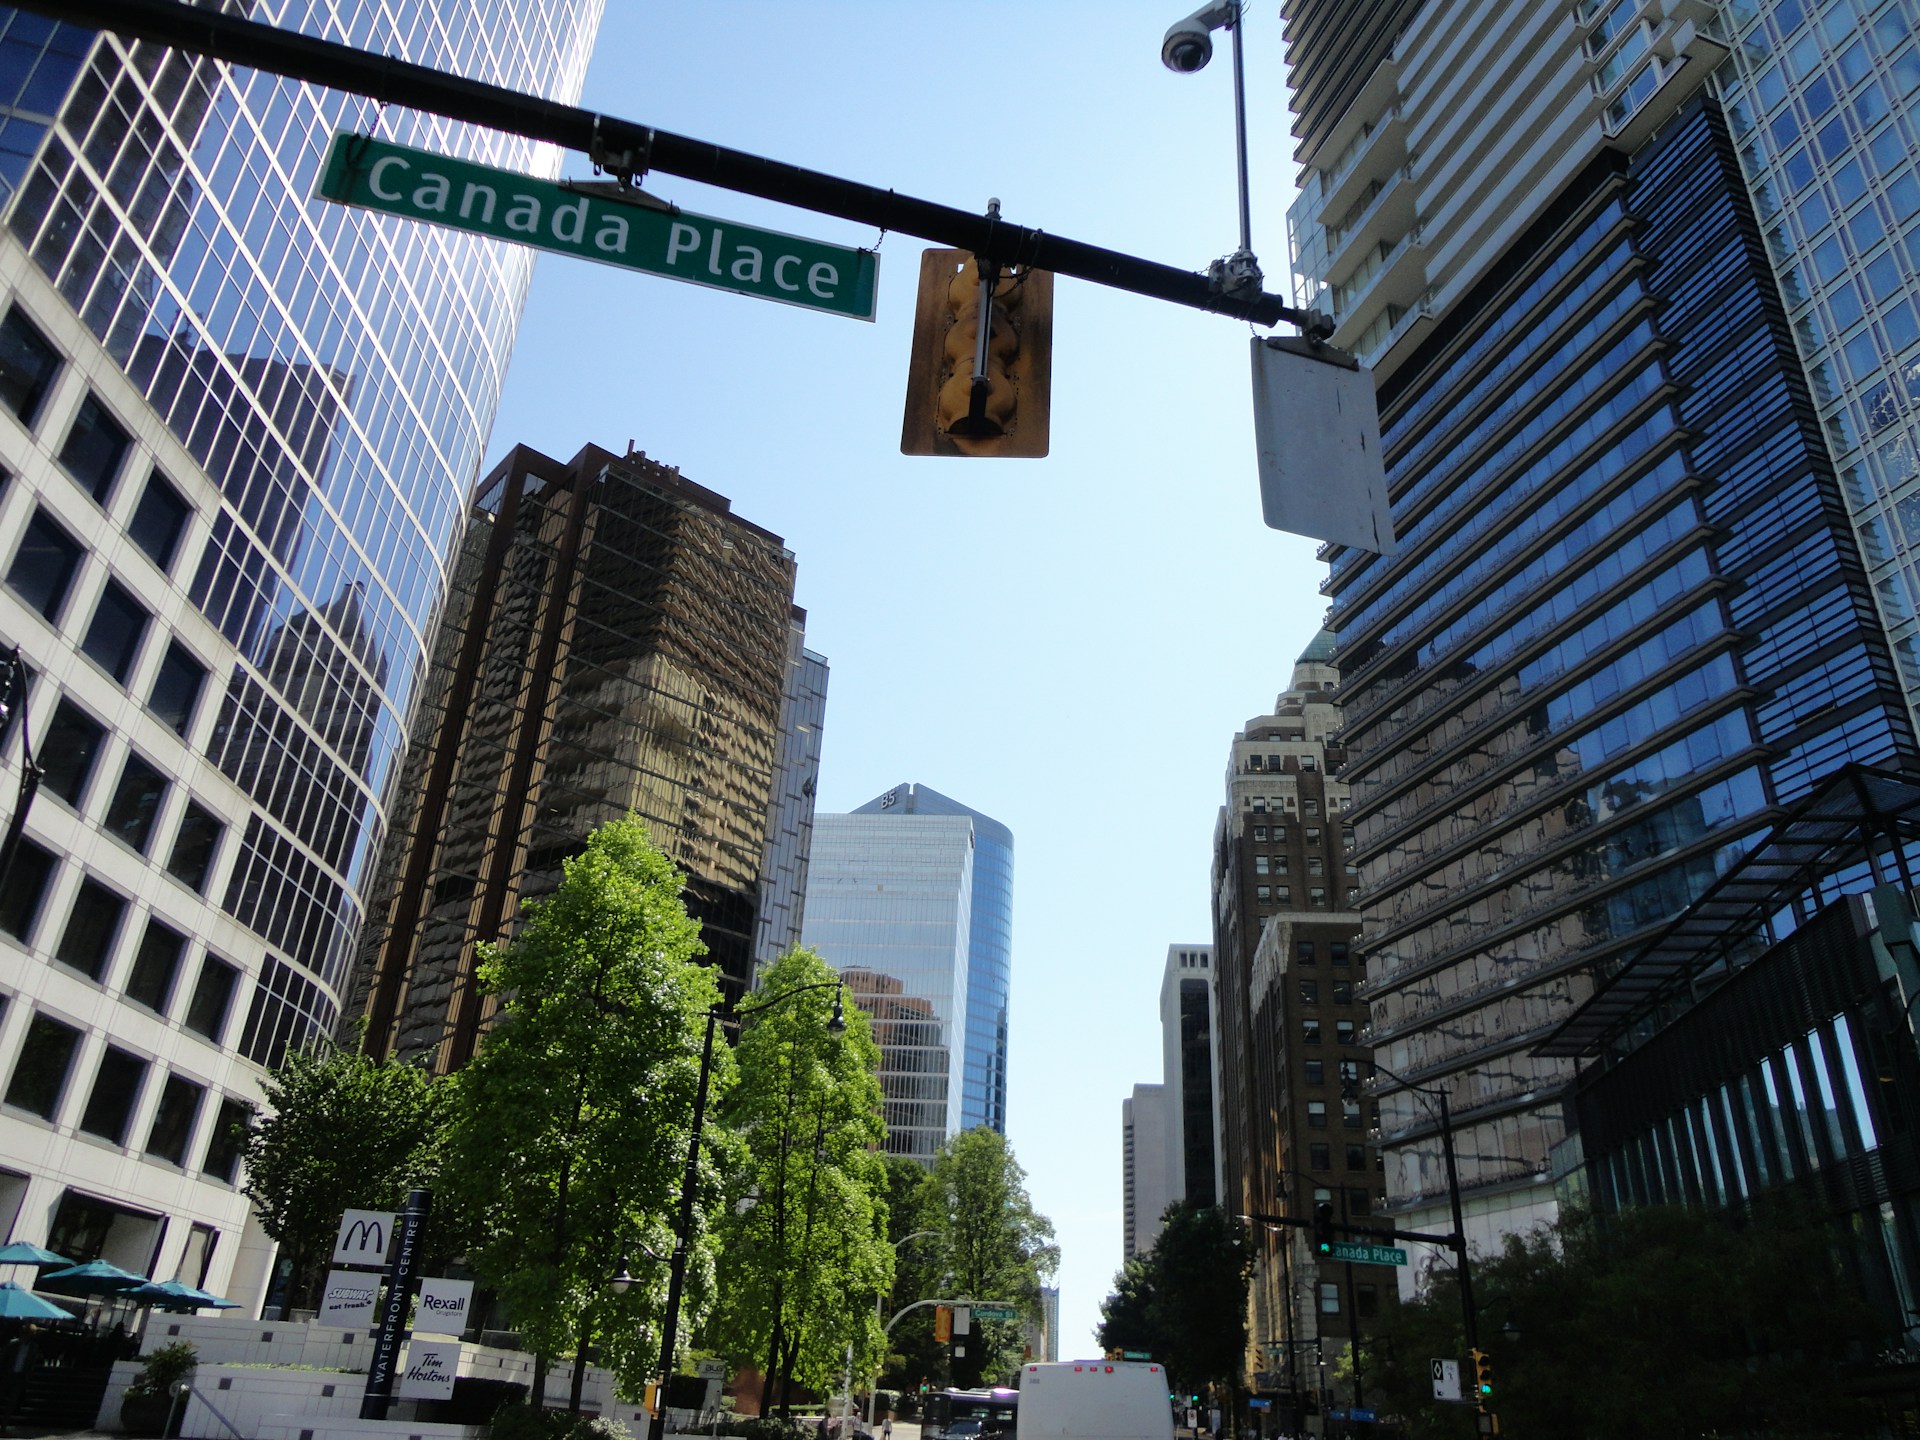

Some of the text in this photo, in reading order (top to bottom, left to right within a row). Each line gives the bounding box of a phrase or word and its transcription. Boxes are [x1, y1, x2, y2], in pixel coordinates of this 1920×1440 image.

[368, 155, 840, 300] Canada Place
[881, 790, 896, 809] B5
[1333, 1246, 1403, 1264] anada Place
[328, 1288, 374, 1300] SUBWAY
[374, 1219, 419, 1384] WATERFRONT CENTRE
[423, 1294, 466, 1311] Rexall
[422, 1353, 444, 1368] Tim
[407, 1366, 450, 1383] Hortons
